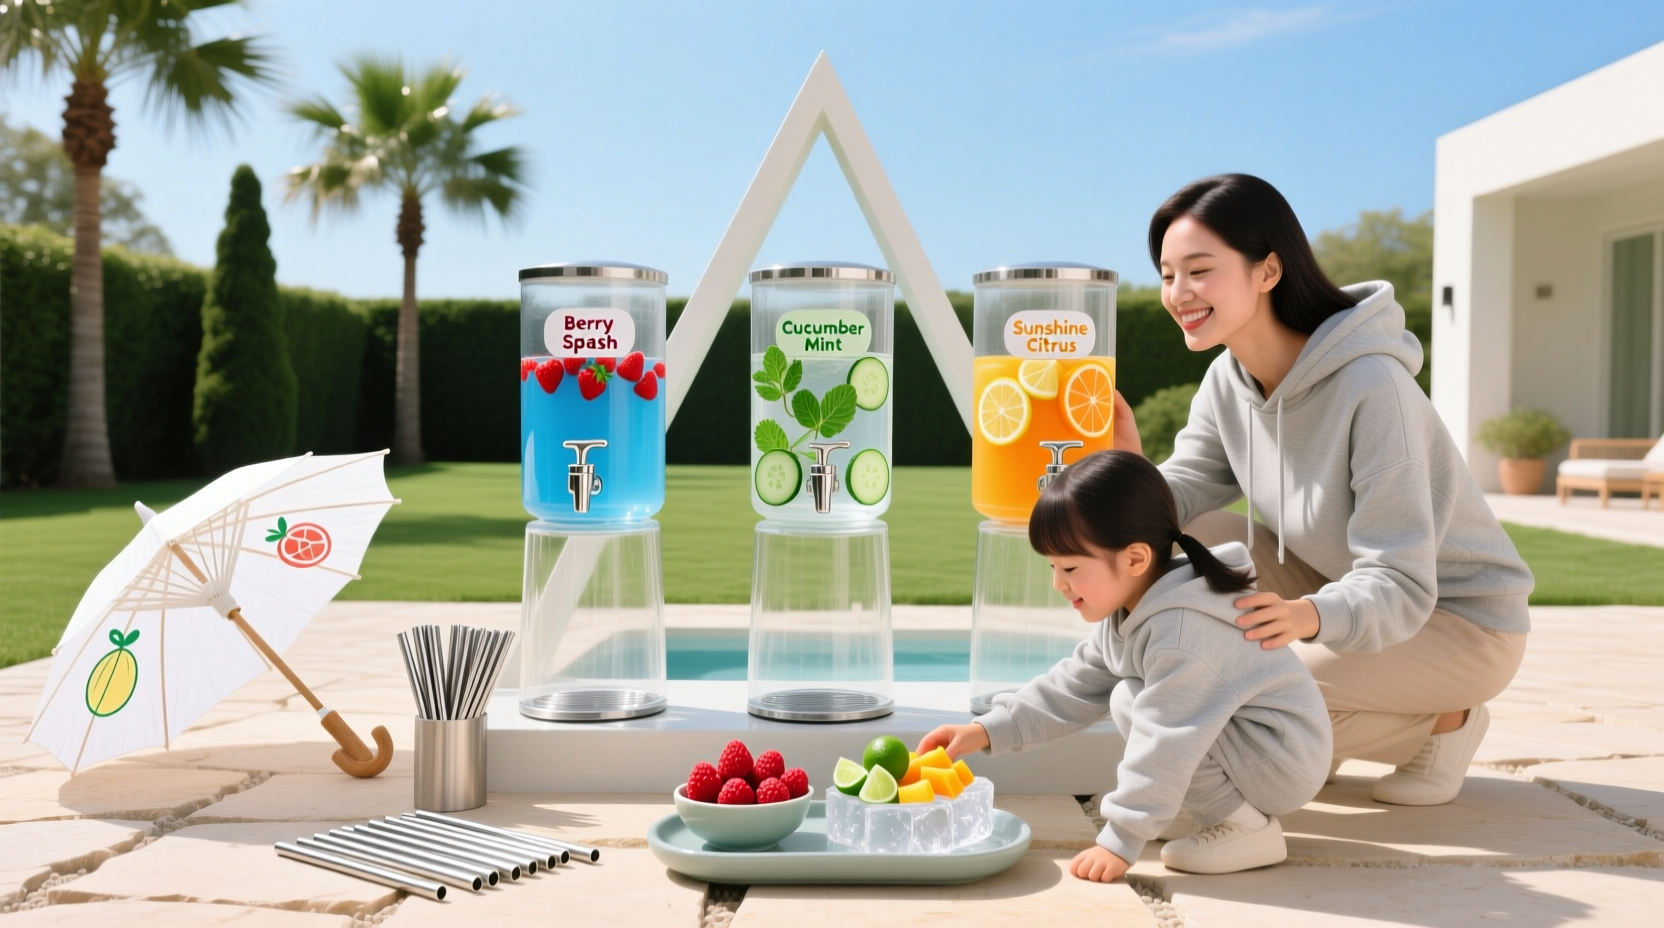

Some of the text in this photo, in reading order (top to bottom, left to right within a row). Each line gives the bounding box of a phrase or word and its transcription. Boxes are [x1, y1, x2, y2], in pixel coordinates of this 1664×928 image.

[564, 315, 614, 335] Berry
[782, 319, 865, 335] Cucumber
[1013, 319, 1088, 335] Sunshine
[563, 334, 618, 354] Spash
[805, 337, 842, 351] Mint
[1027, 337, 1077, 353] Citrus
